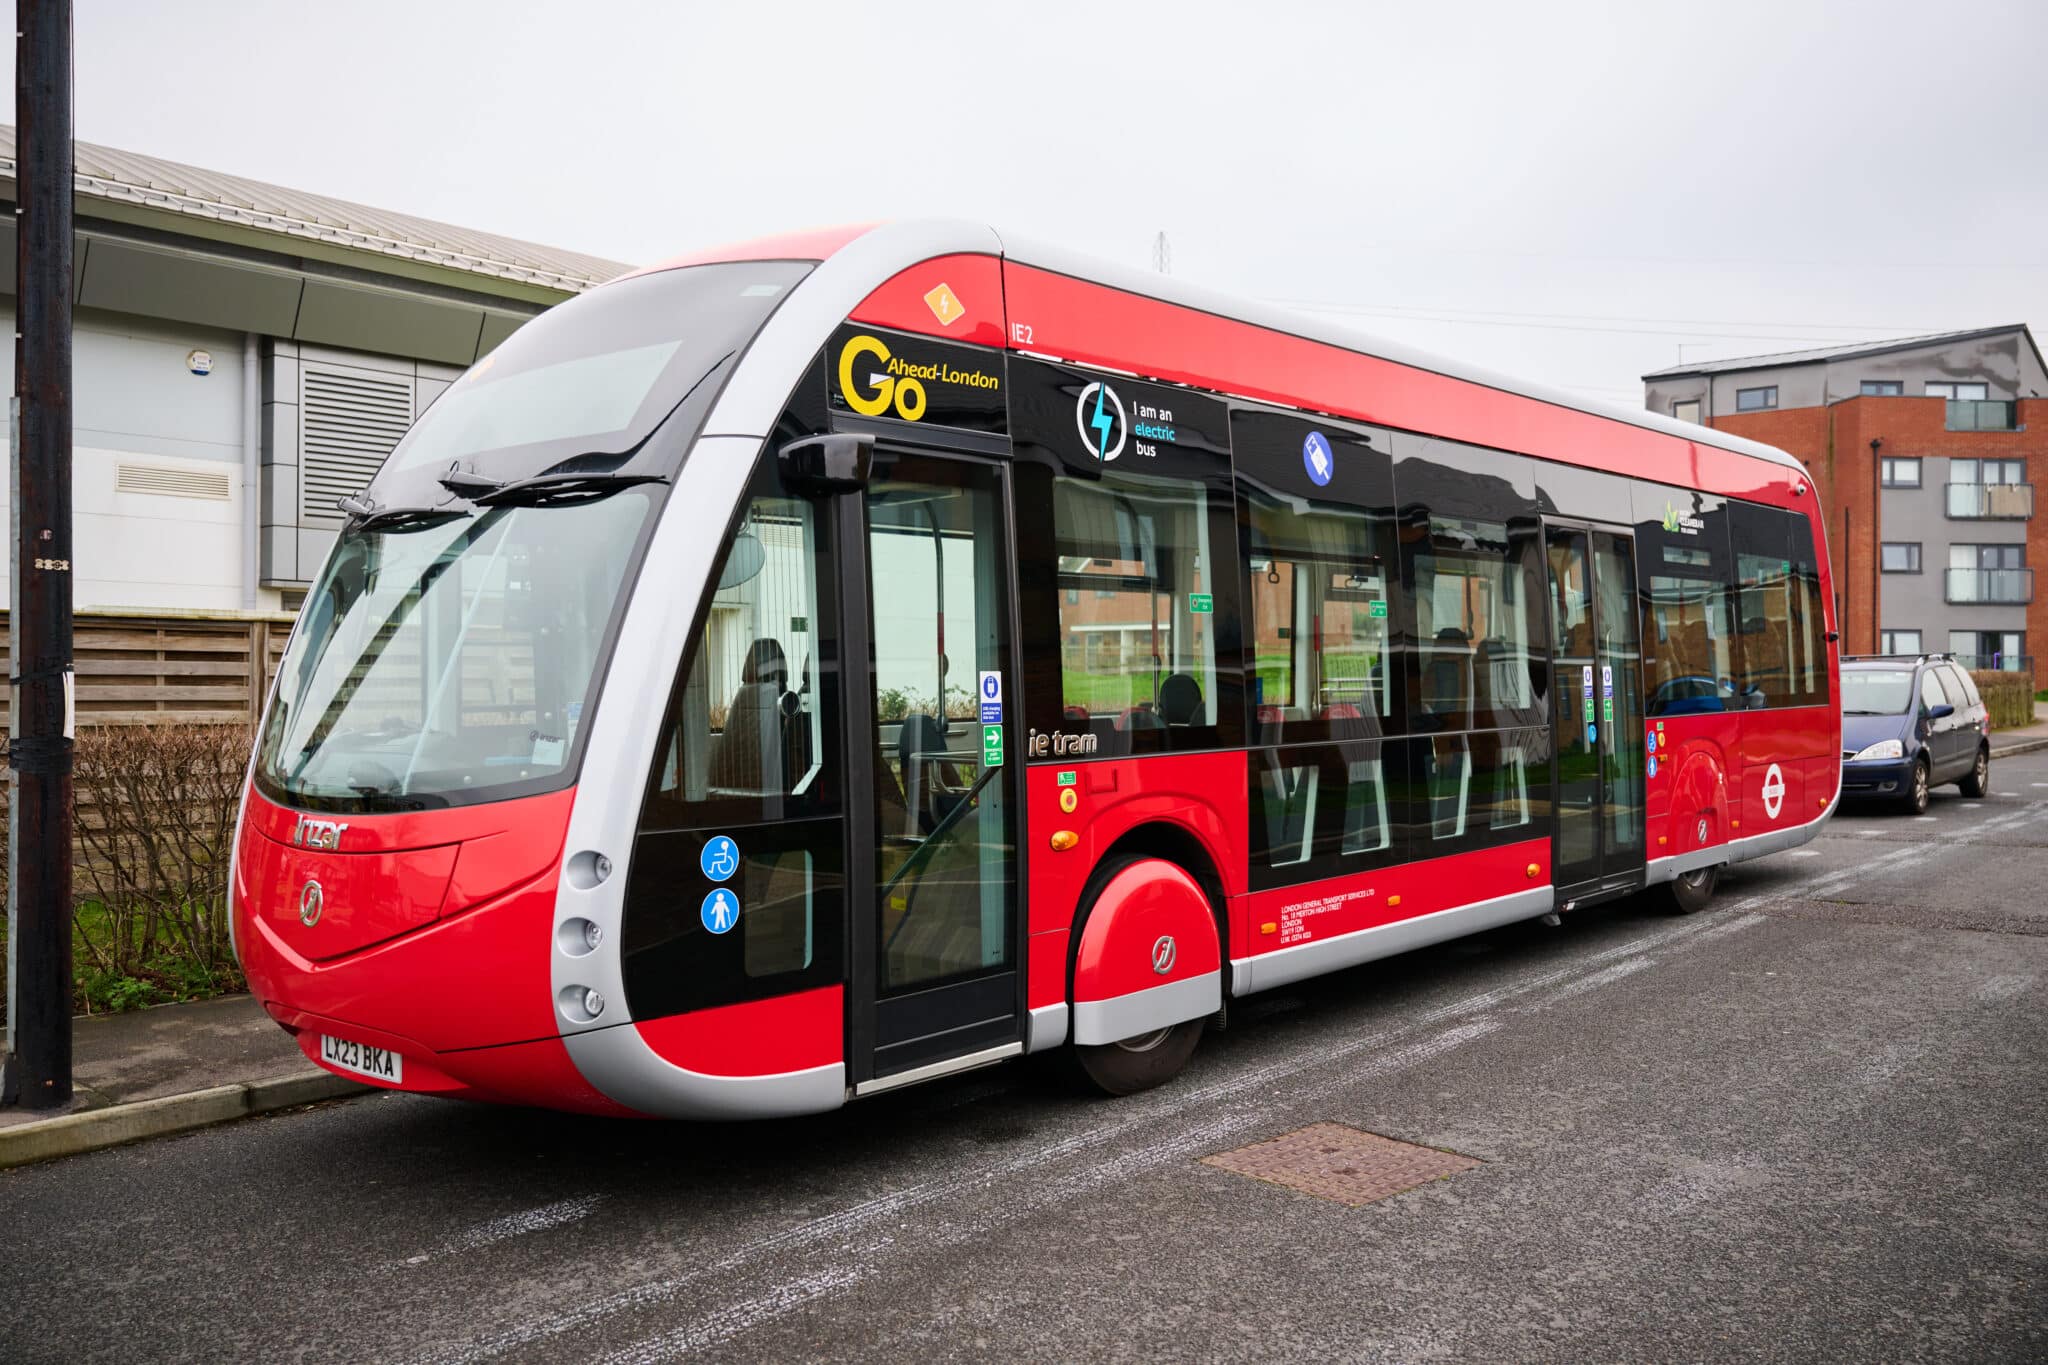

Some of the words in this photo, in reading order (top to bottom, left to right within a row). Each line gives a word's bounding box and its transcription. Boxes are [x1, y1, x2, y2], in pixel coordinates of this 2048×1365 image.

[1011, 322, 1034, 345] IE2
[838, 334, 927, 422] Go
[887, 357, 999, 390] Ahead-London
[1133, 400, 1137, 416] I
[1140, 405, 1157, 420] am
[1159, 409, 1173, 422] an
[1135, 422, 1176, 441] electric
[1136, 440, 1157, 457] bus
[1028, 728, 1050, 757] ie
[1051, 730, 1098, 756] tram
[1281, 904, 1302, 914] LONDON
[1281, 919, 1302, 929] LONDON
[325, 1034, 359, 1067] LX23
[362, 1044, 394, 1077] BKA
